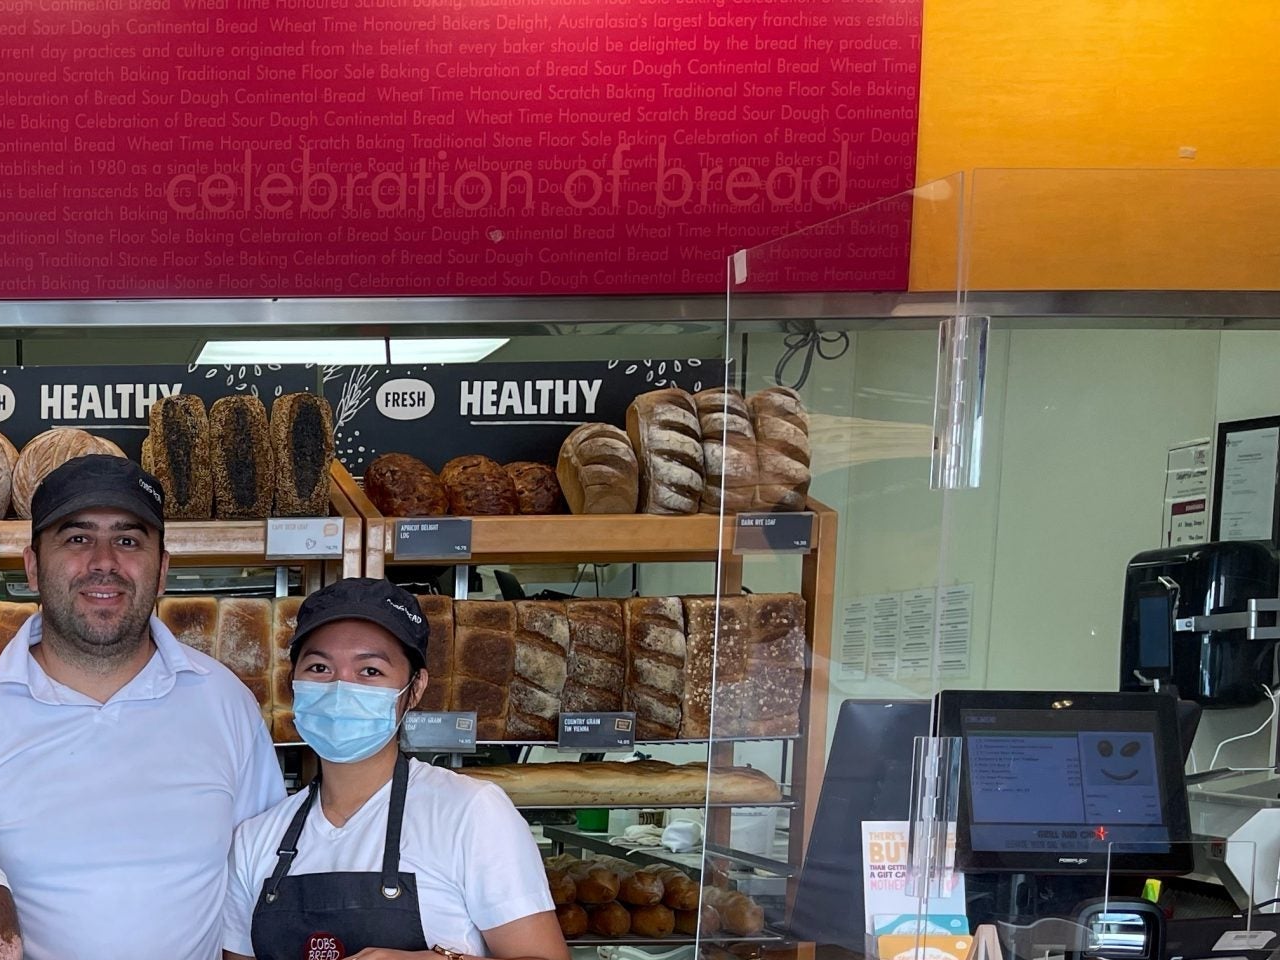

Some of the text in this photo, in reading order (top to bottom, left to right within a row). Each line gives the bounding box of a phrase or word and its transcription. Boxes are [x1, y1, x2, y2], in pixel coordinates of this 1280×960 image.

[32, 18, 66, 35] Sour
[70, 18, 120, 39] Dough
[126, 17, 210, 34] Continental
[216, 16, 258, 33] Bread
[270, 16, 316, 32] Wheat
[322, 15, 358, 32] Time
[364, 15, 436, 31] Honoured
[442, 14, 490, 31] Bakers
[496, 14, 552, 35] Delight,
[558, 13, 648, 29] Australasia's
[654, 12, 702, 33] largest
[708, 12, 758, 33] bakery
[762, 11, 828, 28] franchise
[832, 16, 862, 27] was
[40, 42, 68, 63] day
[72, 43, 136, 62] practices
[142, 41, 170, 57] and
[176, 40, 224, 57] culture
[230, 39, 304, 61] originated
[310, 39, 344, 55] from
[352, 39, 374, 55] the
[380, 38, 420, 55] belief
[424, 38, 454, 54] that
[458, 42, 498, 58] every
[502, 37, 546, 53] baker
[550, 36, 598, 53] should
[606, 36, 624, 52] be
[630, 35, 696, 57] delighted
[702, 35, 720, 56] by
[726, 35, 748, 51] the
[754, 34, 798, 51] bread
[804, 34, 834, 55] they
[838, 33, 902, 55] produce.
[167, 140, 847, 213] celebration of bread
[385, 391, 426, 408] FRESH
[460, 379, 602, 416] HEALTHY
[310, 938, 337, 950] COBS
